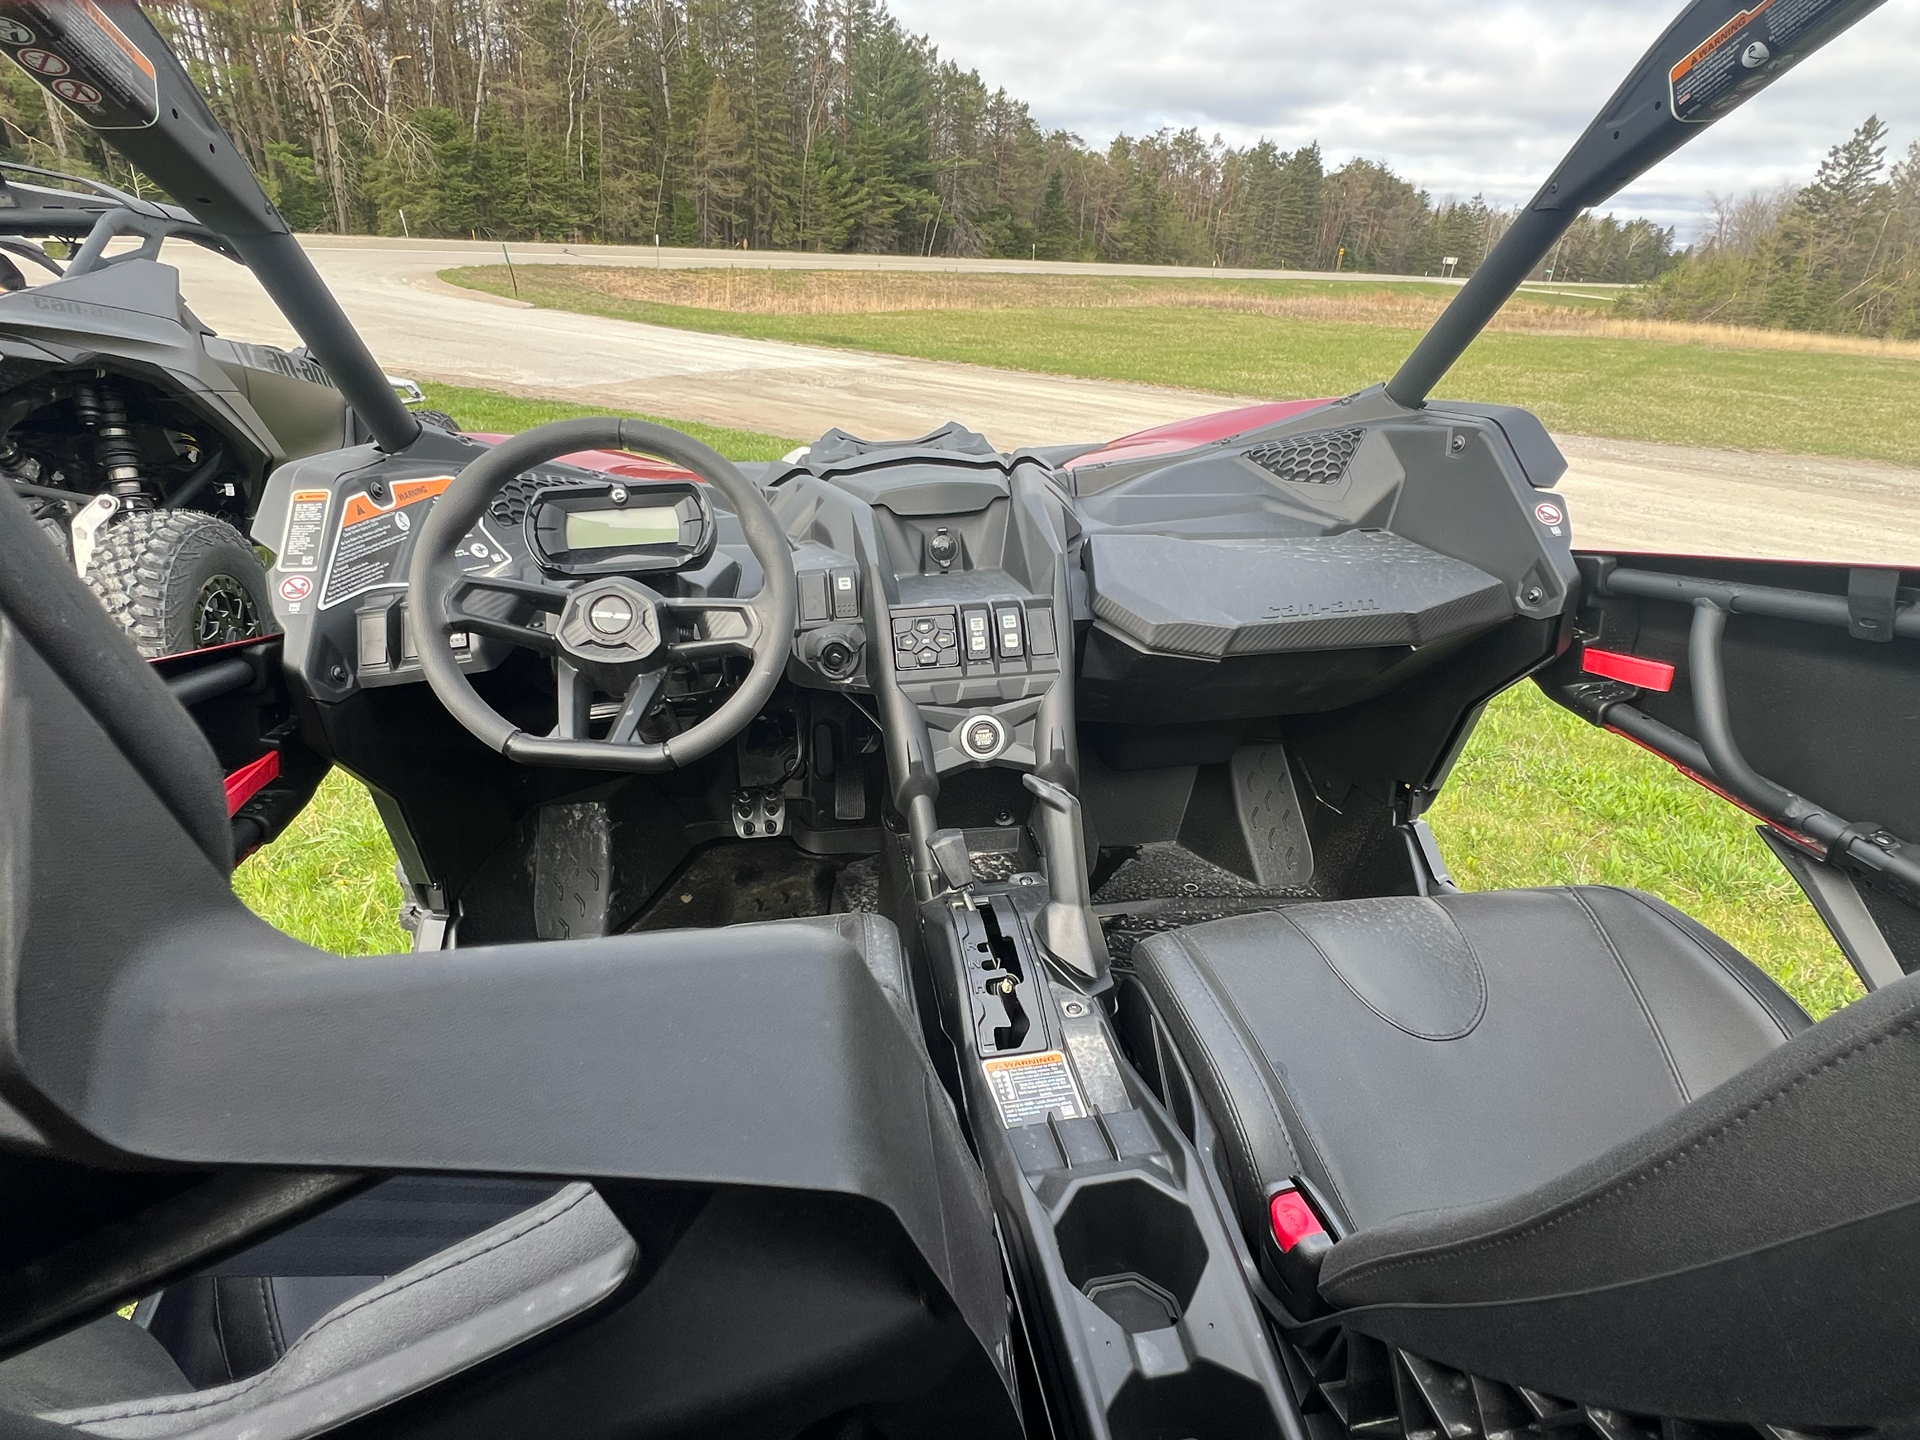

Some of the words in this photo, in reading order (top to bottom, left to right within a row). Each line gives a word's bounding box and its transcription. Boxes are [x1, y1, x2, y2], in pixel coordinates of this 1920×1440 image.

[1698, 16, 1747, 60] WARNING
[397, 485, 427, 502] WARNING
[591, 611, 631, 620] can-am
[1261, 599, 1381, 619] can-am
[975, 732, 993, 740] START
[966, 942, 977, 951] R
[969, 959, 981, 969] N
[974, 981, 986, 994] H
[1004, 1055, 1055, 1068] WARNING
